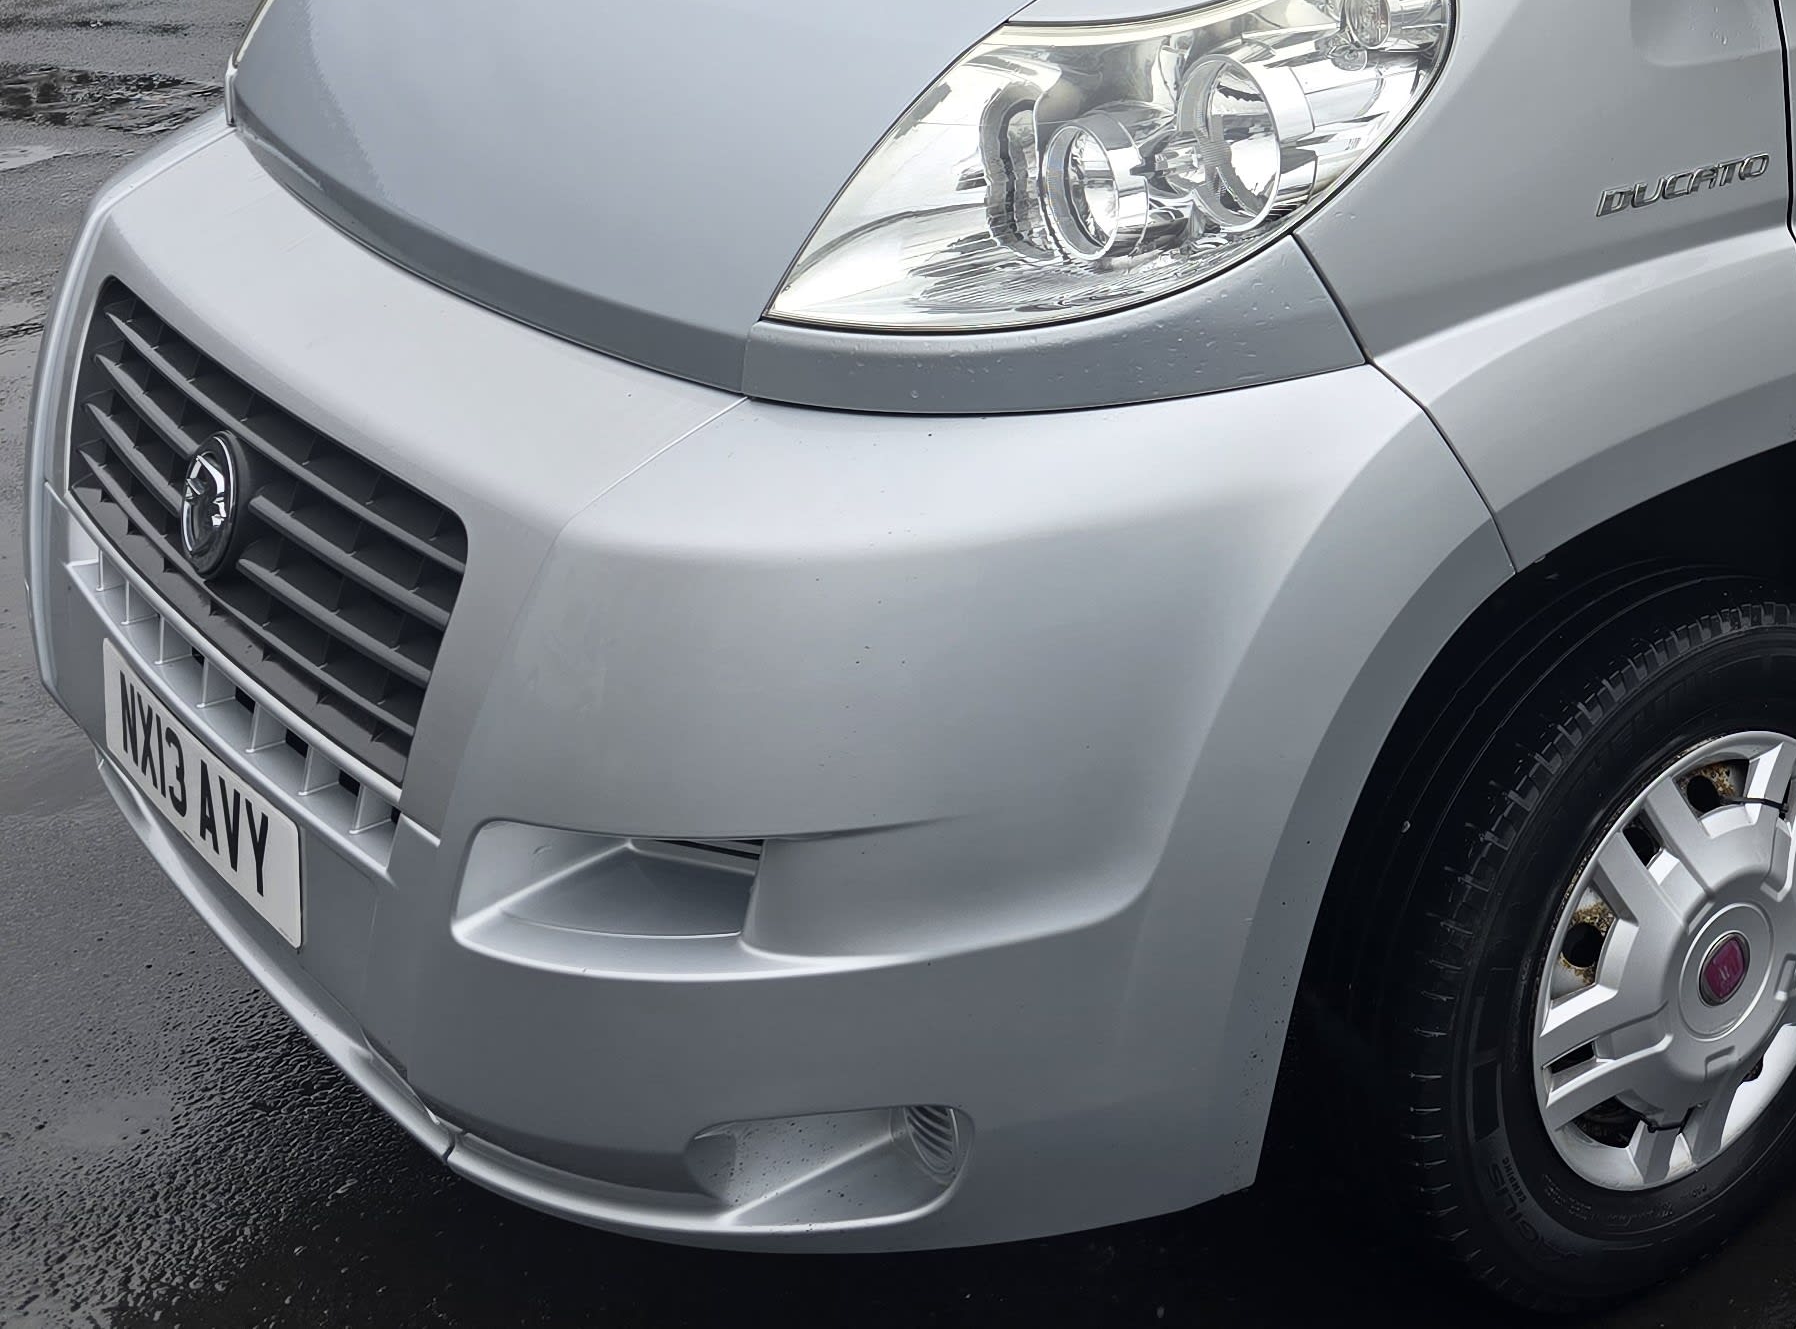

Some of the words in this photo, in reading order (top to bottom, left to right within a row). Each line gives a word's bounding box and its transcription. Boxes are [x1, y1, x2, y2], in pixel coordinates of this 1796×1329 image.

[1596, 153, 1770, 217] DUCATO
[120, 670, 187, 818] NX13
[200, 759, 269, 898] AVY
